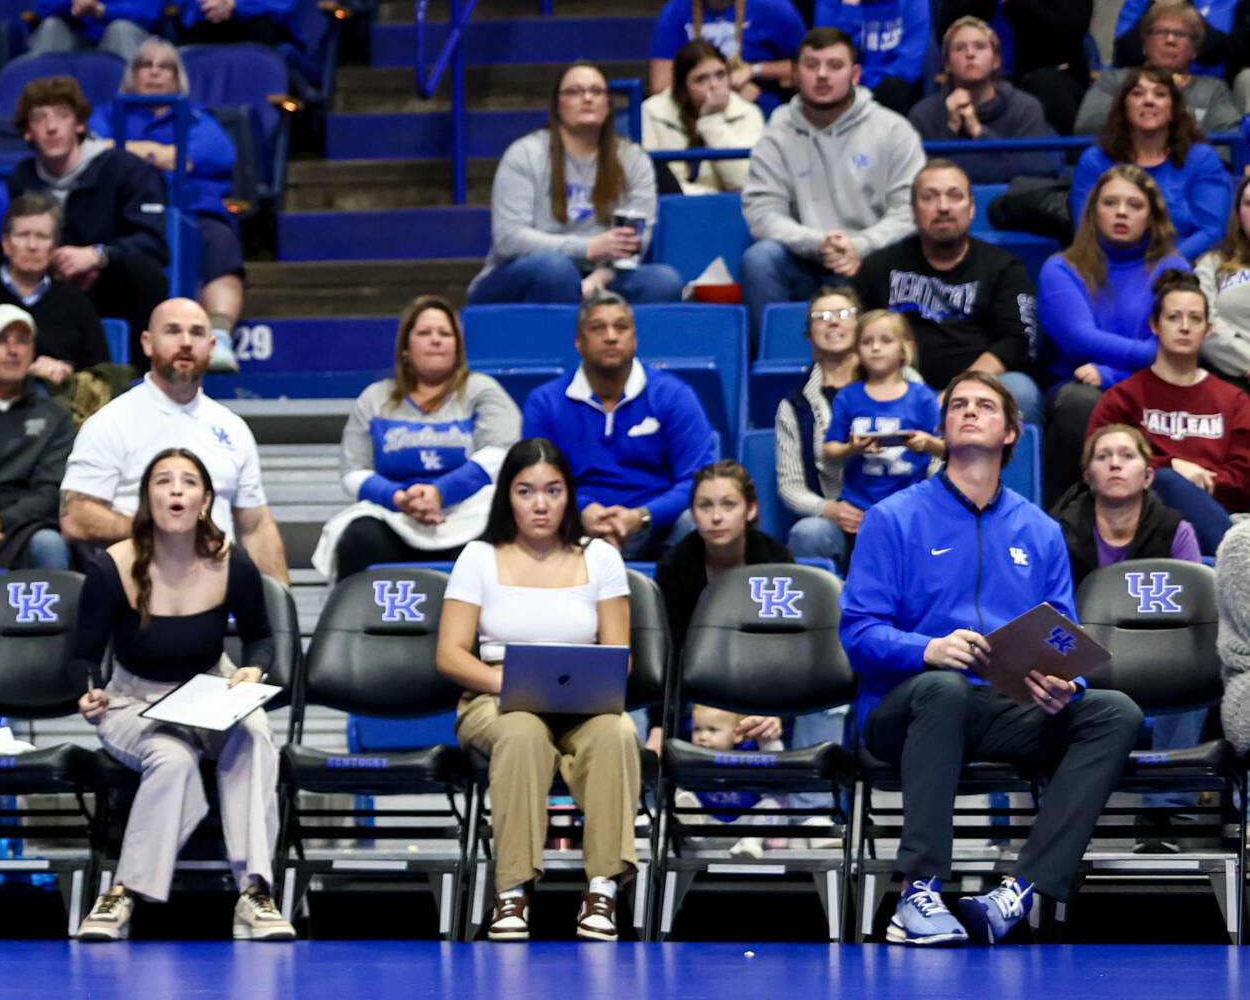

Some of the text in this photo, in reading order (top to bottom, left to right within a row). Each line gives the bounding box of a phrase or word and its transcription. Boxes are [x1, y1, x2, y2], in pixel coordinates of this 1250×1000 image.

[237, 324, 273, 360] 29
[1009, 547, 1029, 566] UK
[7, 581, 60, 623] UK
[372, 580, 427, 622] UK
[749, 576, 804, 619] UK
[1124, 571, 1184, 614] UK
[1045, 624, 1078, 657] UK
